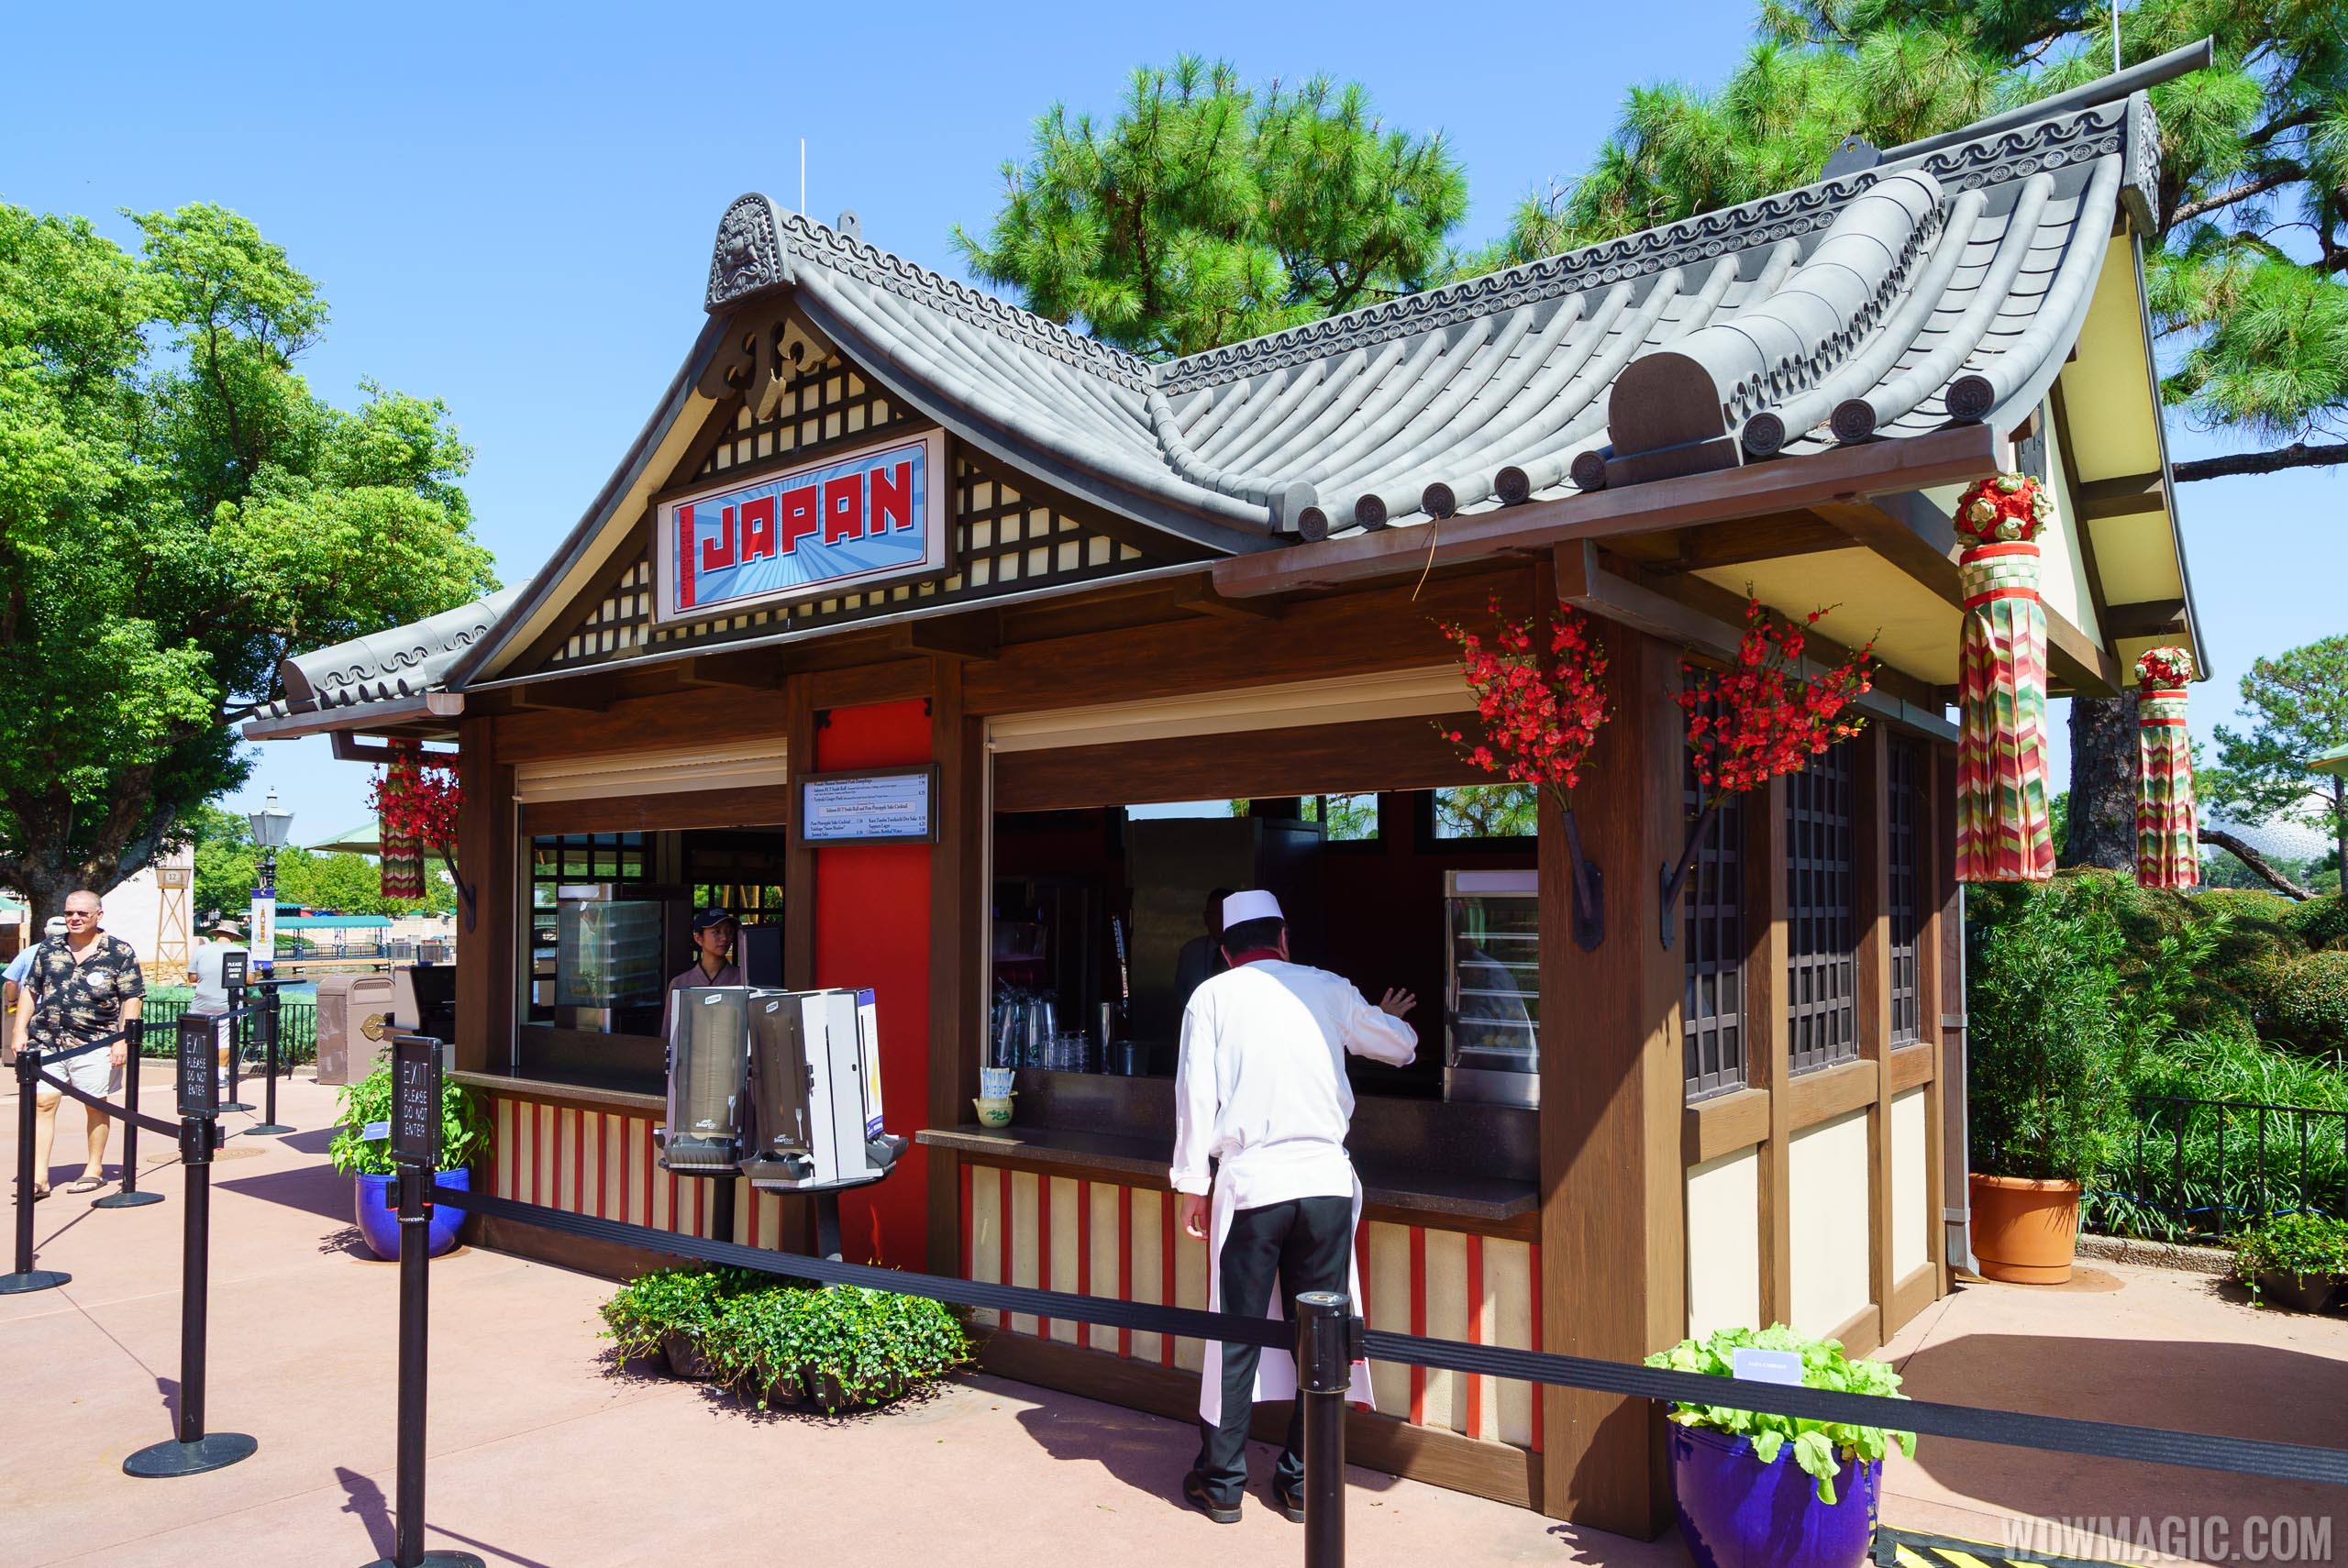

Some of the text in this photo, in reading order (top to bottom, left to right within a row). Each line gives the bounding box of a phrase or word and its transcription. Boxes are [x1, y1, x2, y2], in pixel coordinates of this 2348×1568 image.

[702, 459, 914, 573] JAPAN
[186, 1034, 207, 1055] EXIT
[186, 1057, 207, 1069] PLEASE
[186, 1070, 207, 1083] DO NOT
[404, 1060, 428, 1087] EXIT
[188, 1084, 206, 1098] ENTER
[404, 1088, 428, 1105] PLEASE
[404, 1105, 428, 1121] DO NOT
[404, 1122, 426, 1138] ENTER
